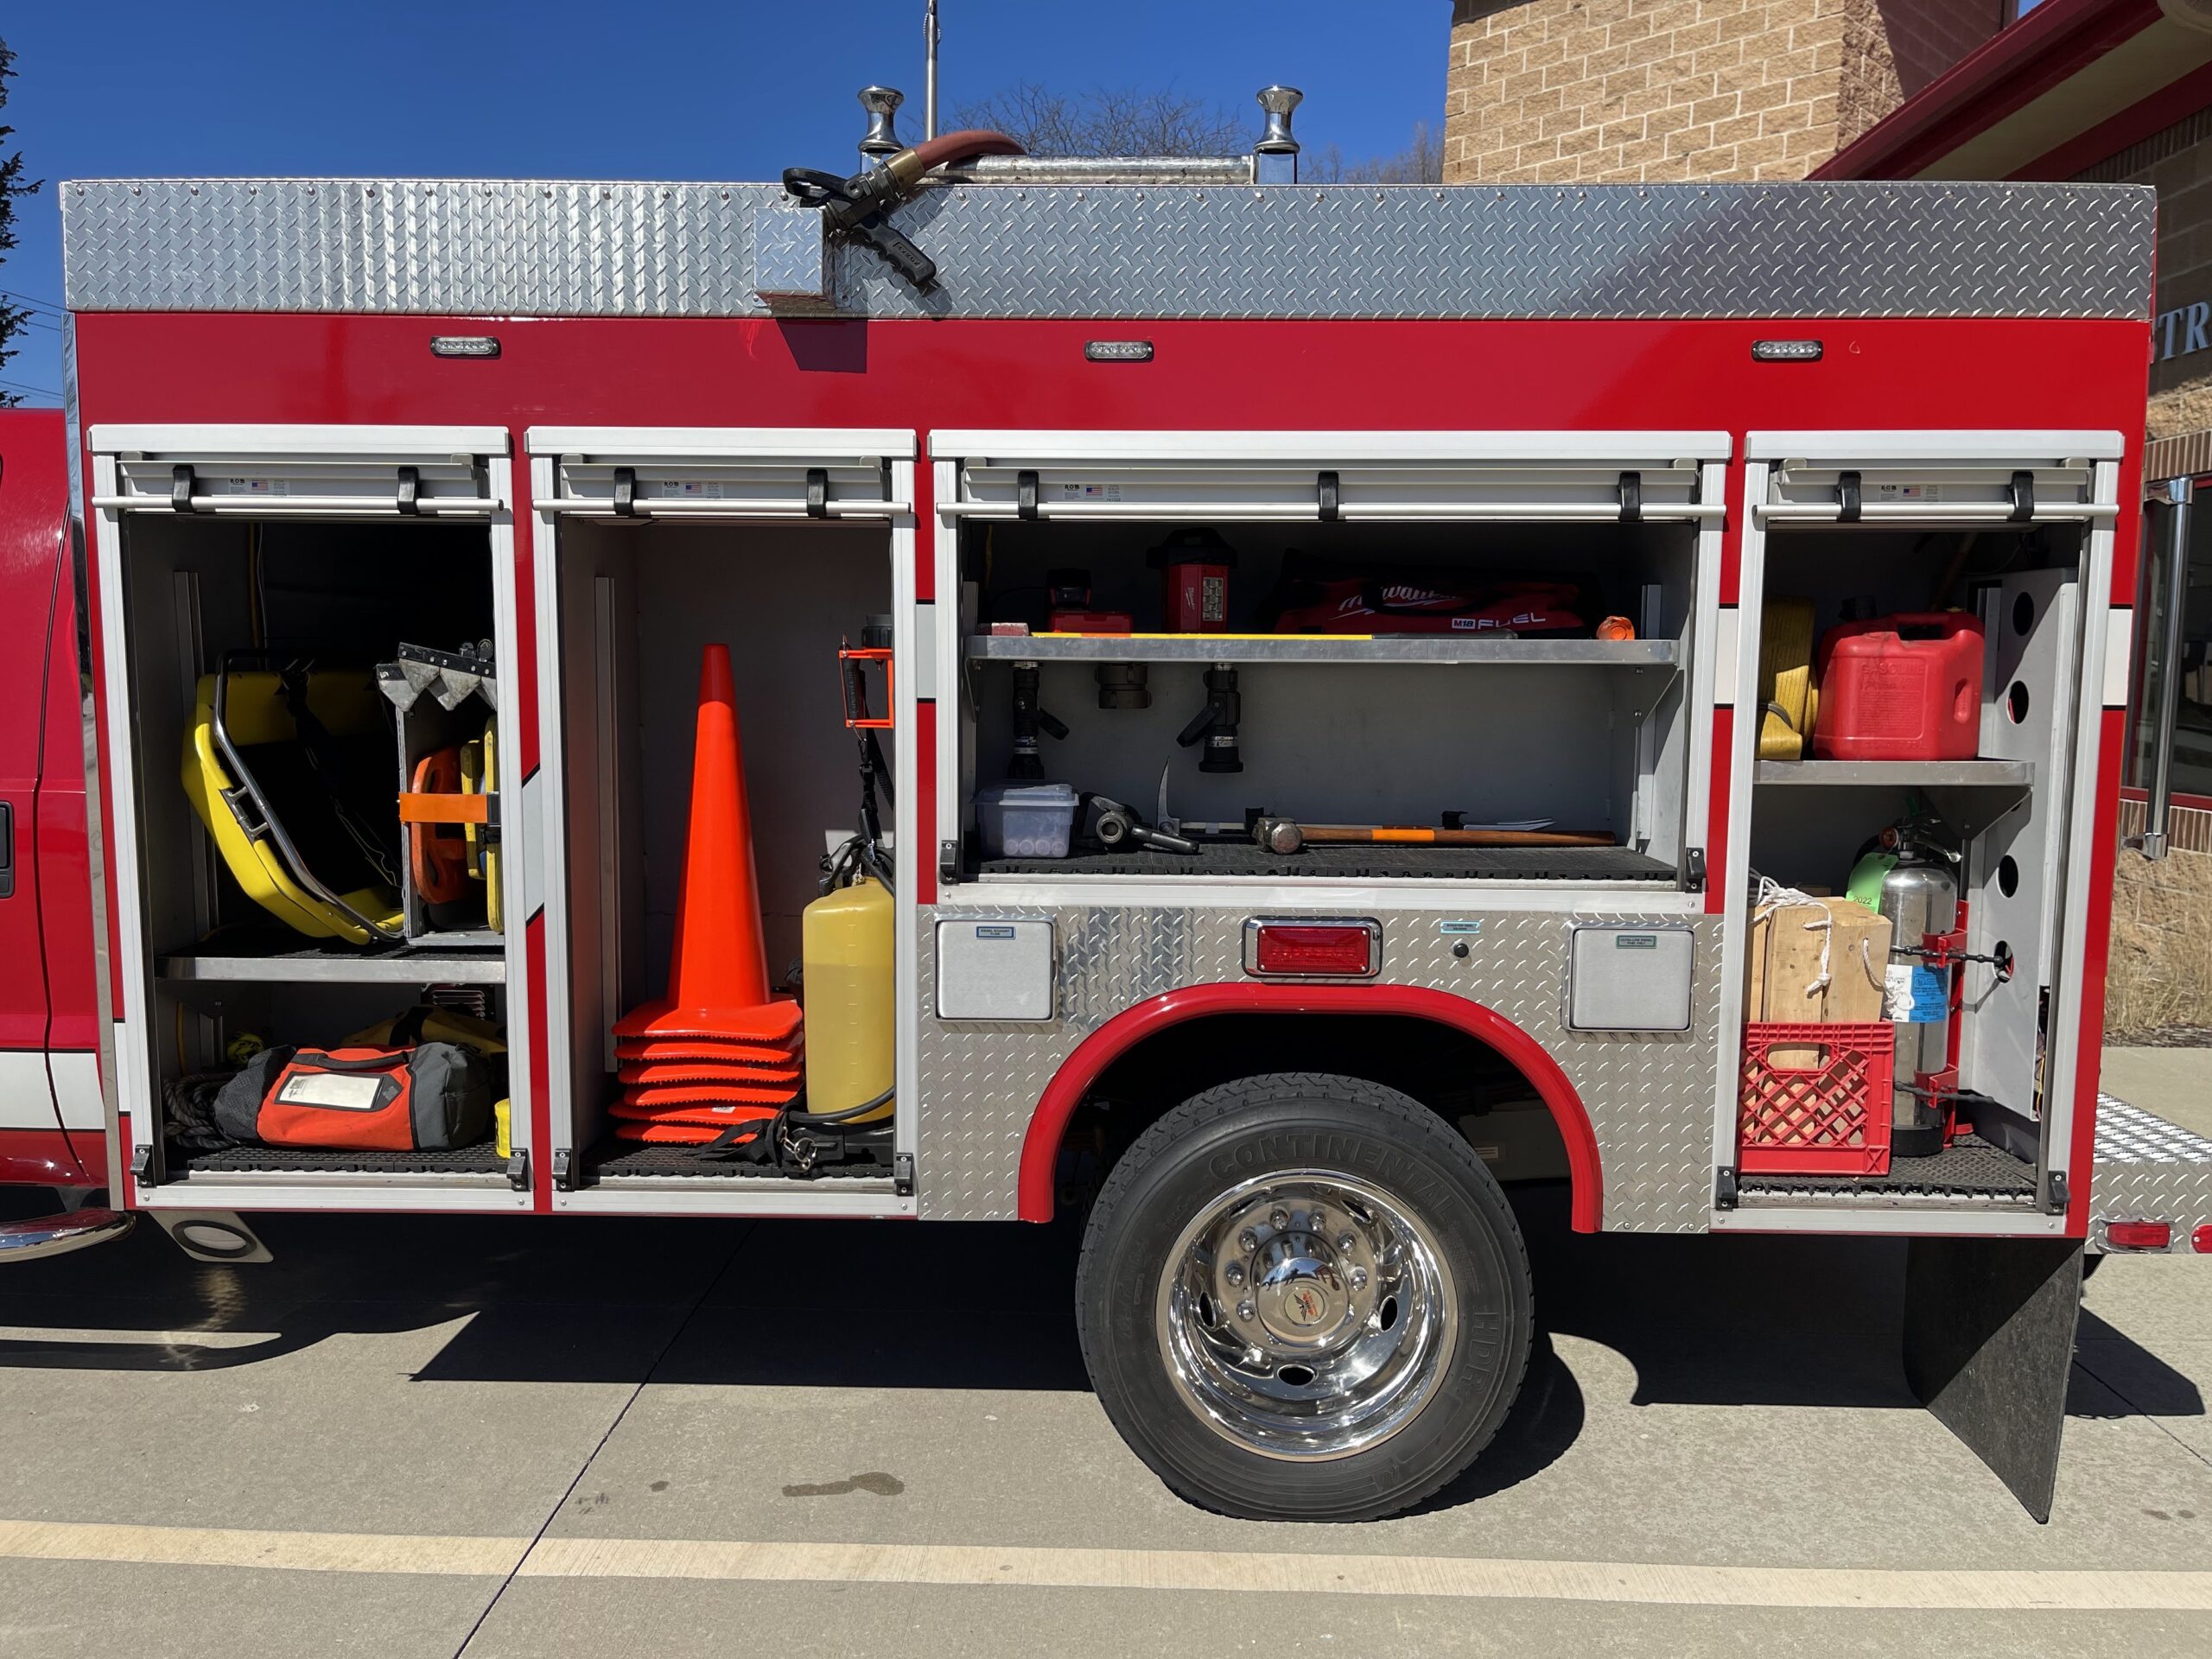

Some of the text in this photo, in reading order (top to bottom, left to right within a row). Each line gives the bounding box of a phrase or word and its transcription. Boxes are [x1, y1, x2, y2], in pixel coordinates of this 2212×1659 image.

[2156, 301, 2212, 360] TR
[1453, 612, 1547, 630] M18 FUEL
[1853, 895, 1872, 906] 2022
[1210, 1133, 1458, 1224] CONTINENTAL
